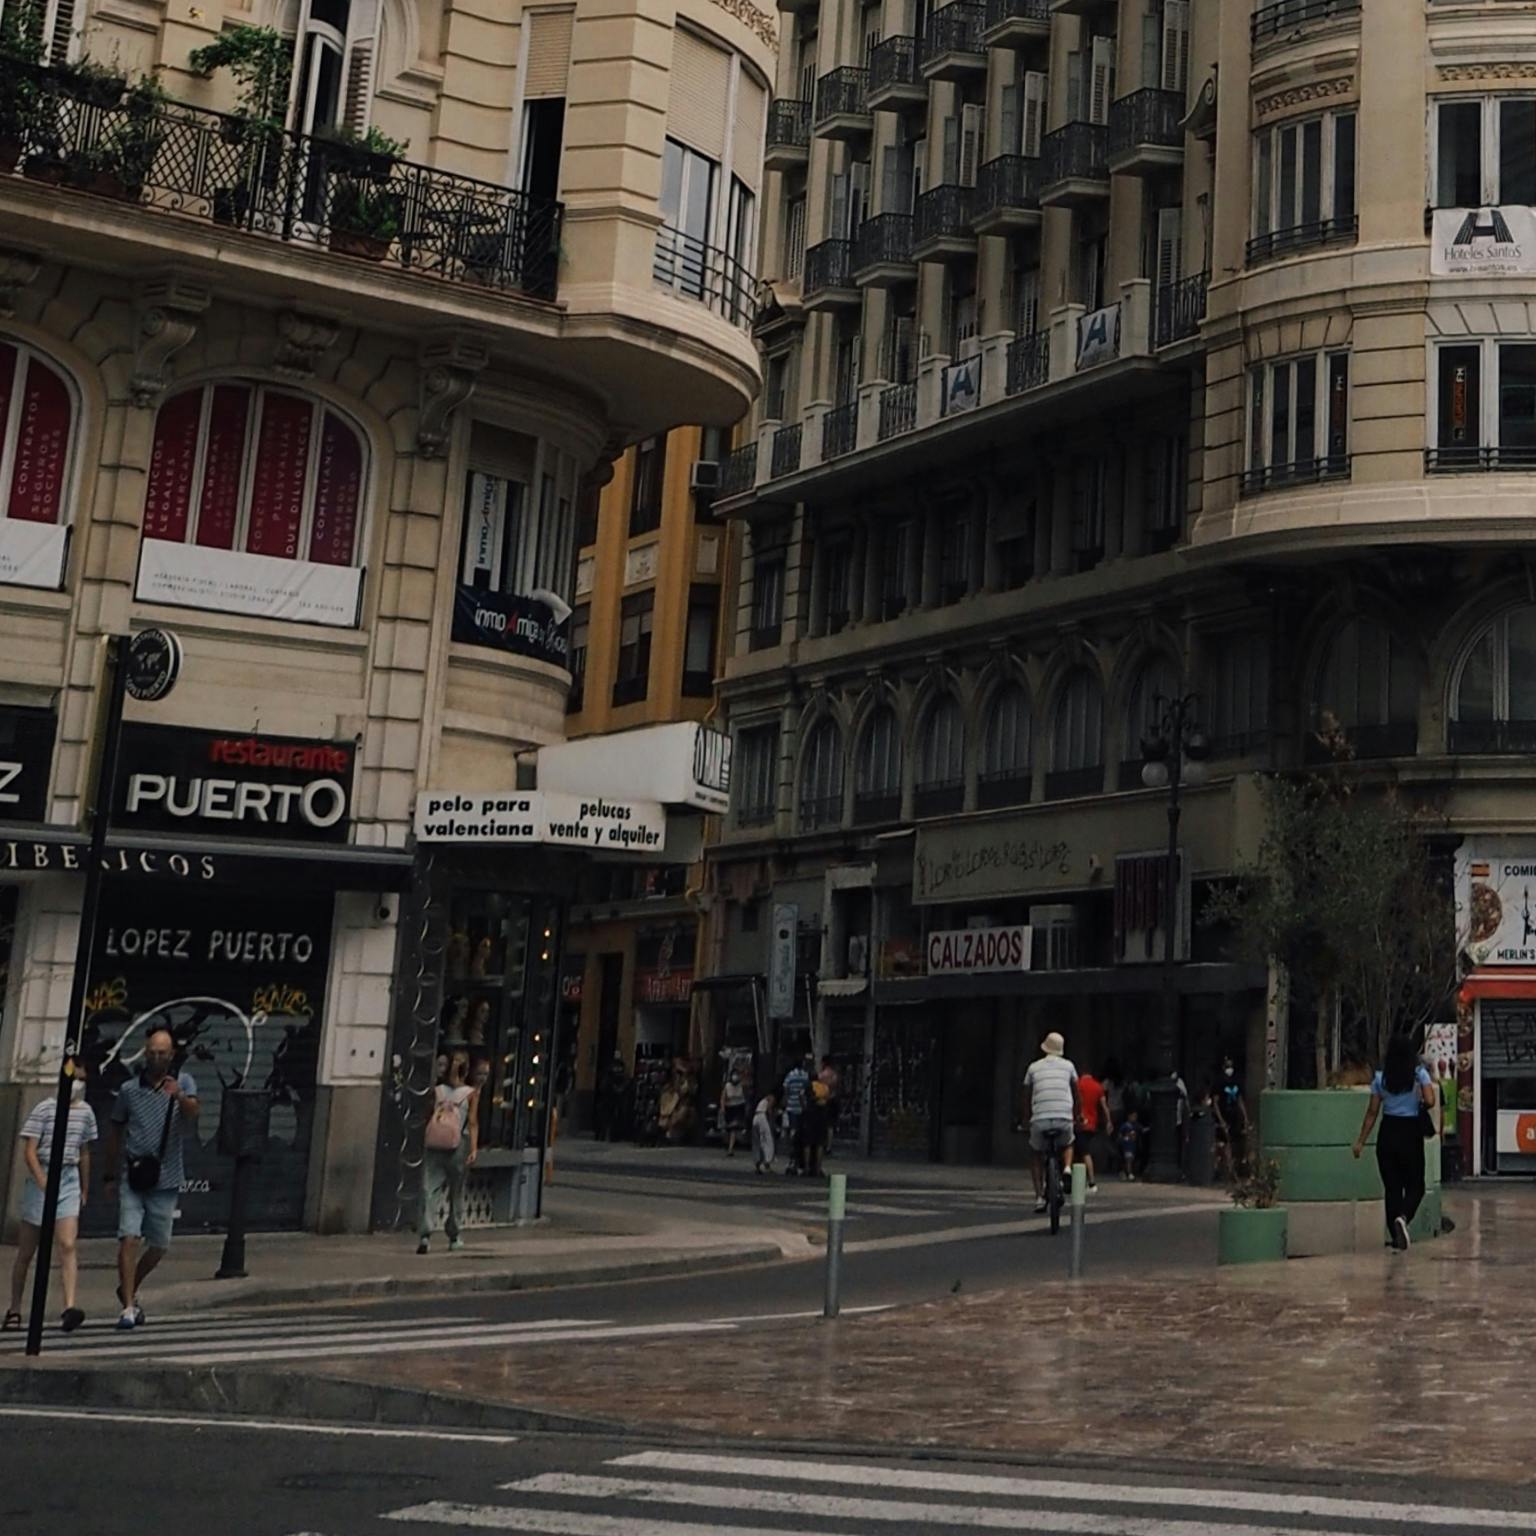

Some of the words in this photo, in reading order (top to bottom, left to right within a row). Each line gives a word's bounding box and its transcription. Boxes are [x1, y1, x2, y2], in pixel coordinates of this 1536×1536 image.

[1444, 245, 1484, 260] Hoteles
[144, 439, 165, 531] SERVICIOS
[160, 457, 176, 533] LEGALES
[208, 739, 348, 773] restaurante
[124, 773, 347, 828] PUERTO
[428, 795, 473, 815] pelo
[481, 800, 531, 816] para
[580, 799, 632, 820] pelucas
[424, 819, 534, 836] valenciana
[549, 819, 589, 840] venta
[594, 826, 604, 845] y
[608, 822, 660, 847] alquiler
[106, 928, 192, 960] LOPEZ
[208, 929, 313, 964] PUERTO
[930, 930, 1023, 969] CALZADOS
[1497, 948, 1536, 961] MERLIN'S
